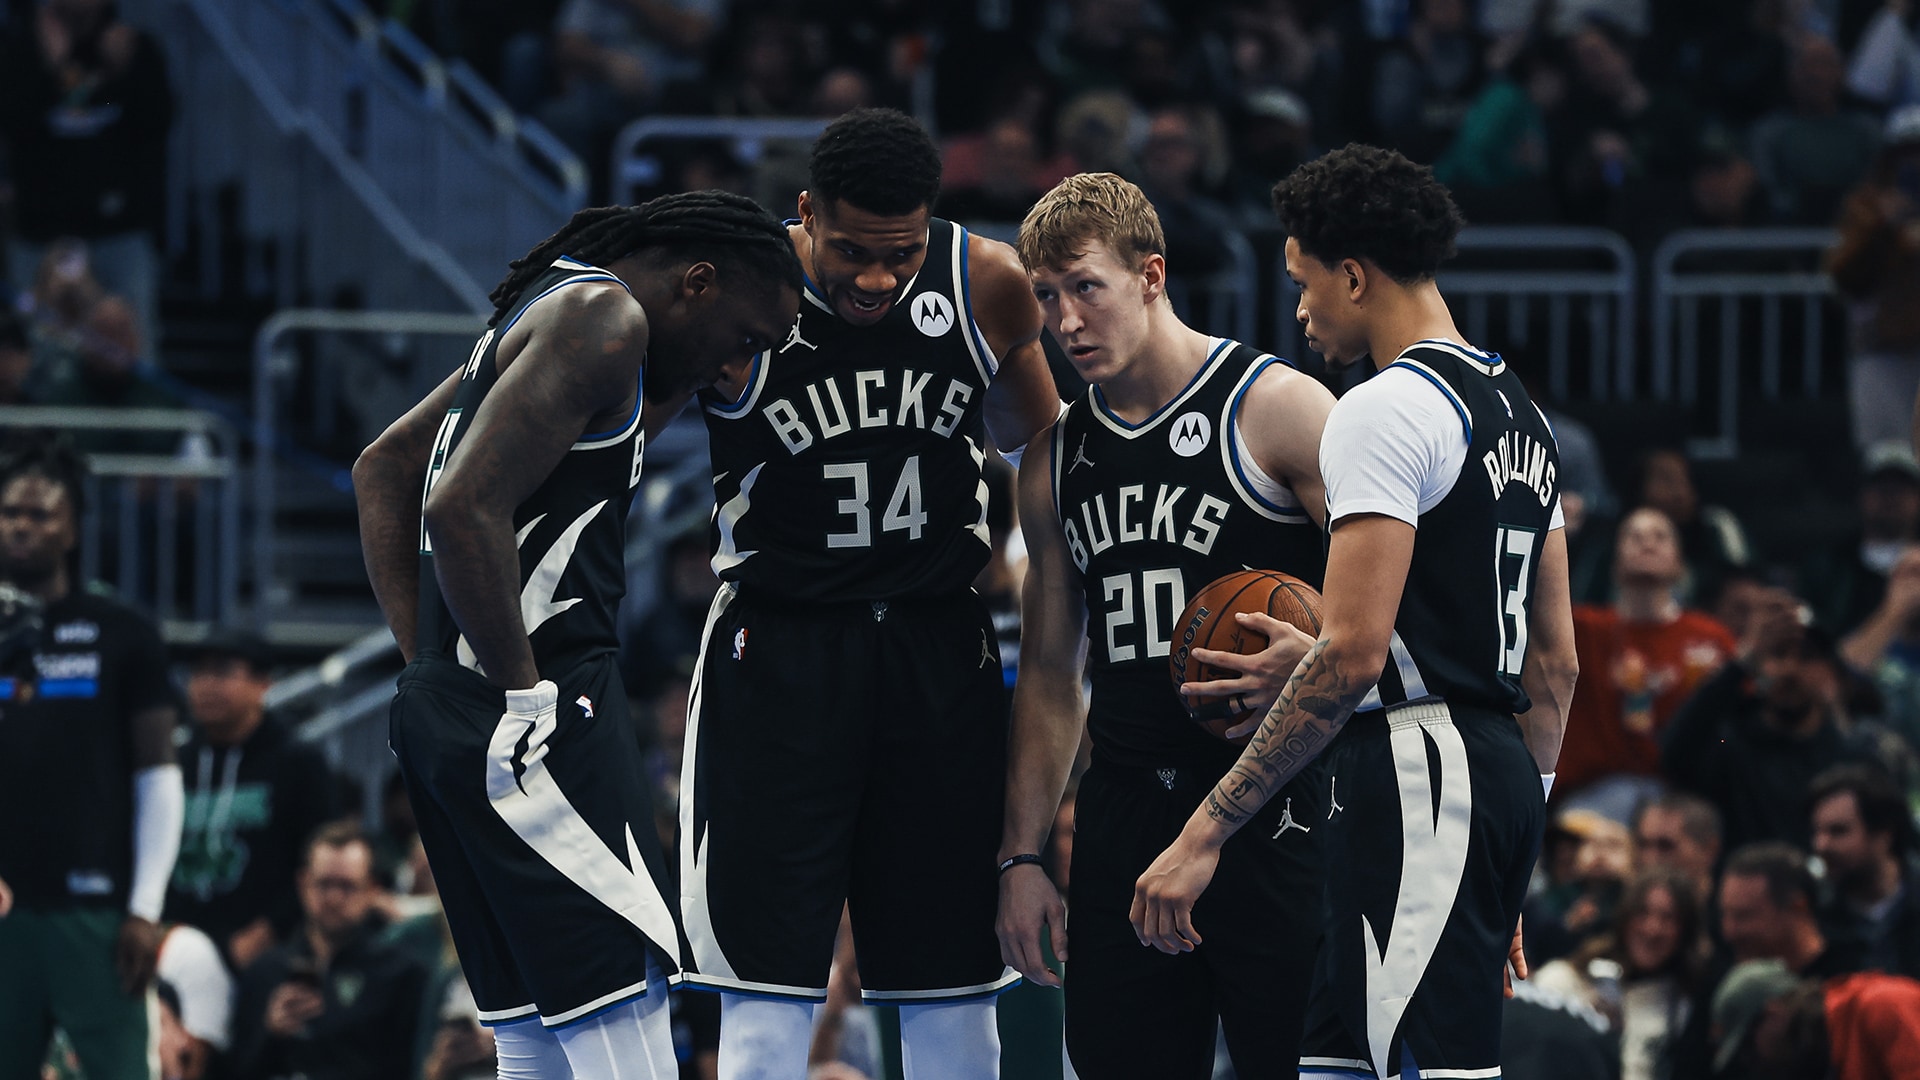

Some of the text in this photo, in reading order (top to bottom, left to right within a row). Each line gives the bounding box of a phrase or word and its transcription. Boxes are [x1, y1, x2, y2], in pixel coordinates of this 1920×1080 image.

[762, 368, 974, 456] BUCKS
[823, 455, 928, 549] 34
[1482, 430, 1556, 508] ROLLINS
[1064, 483, 1231, 574] BUCKS
[1102, 567, 1187, 664] 20
[1494, 525, 1536, 677] 13
